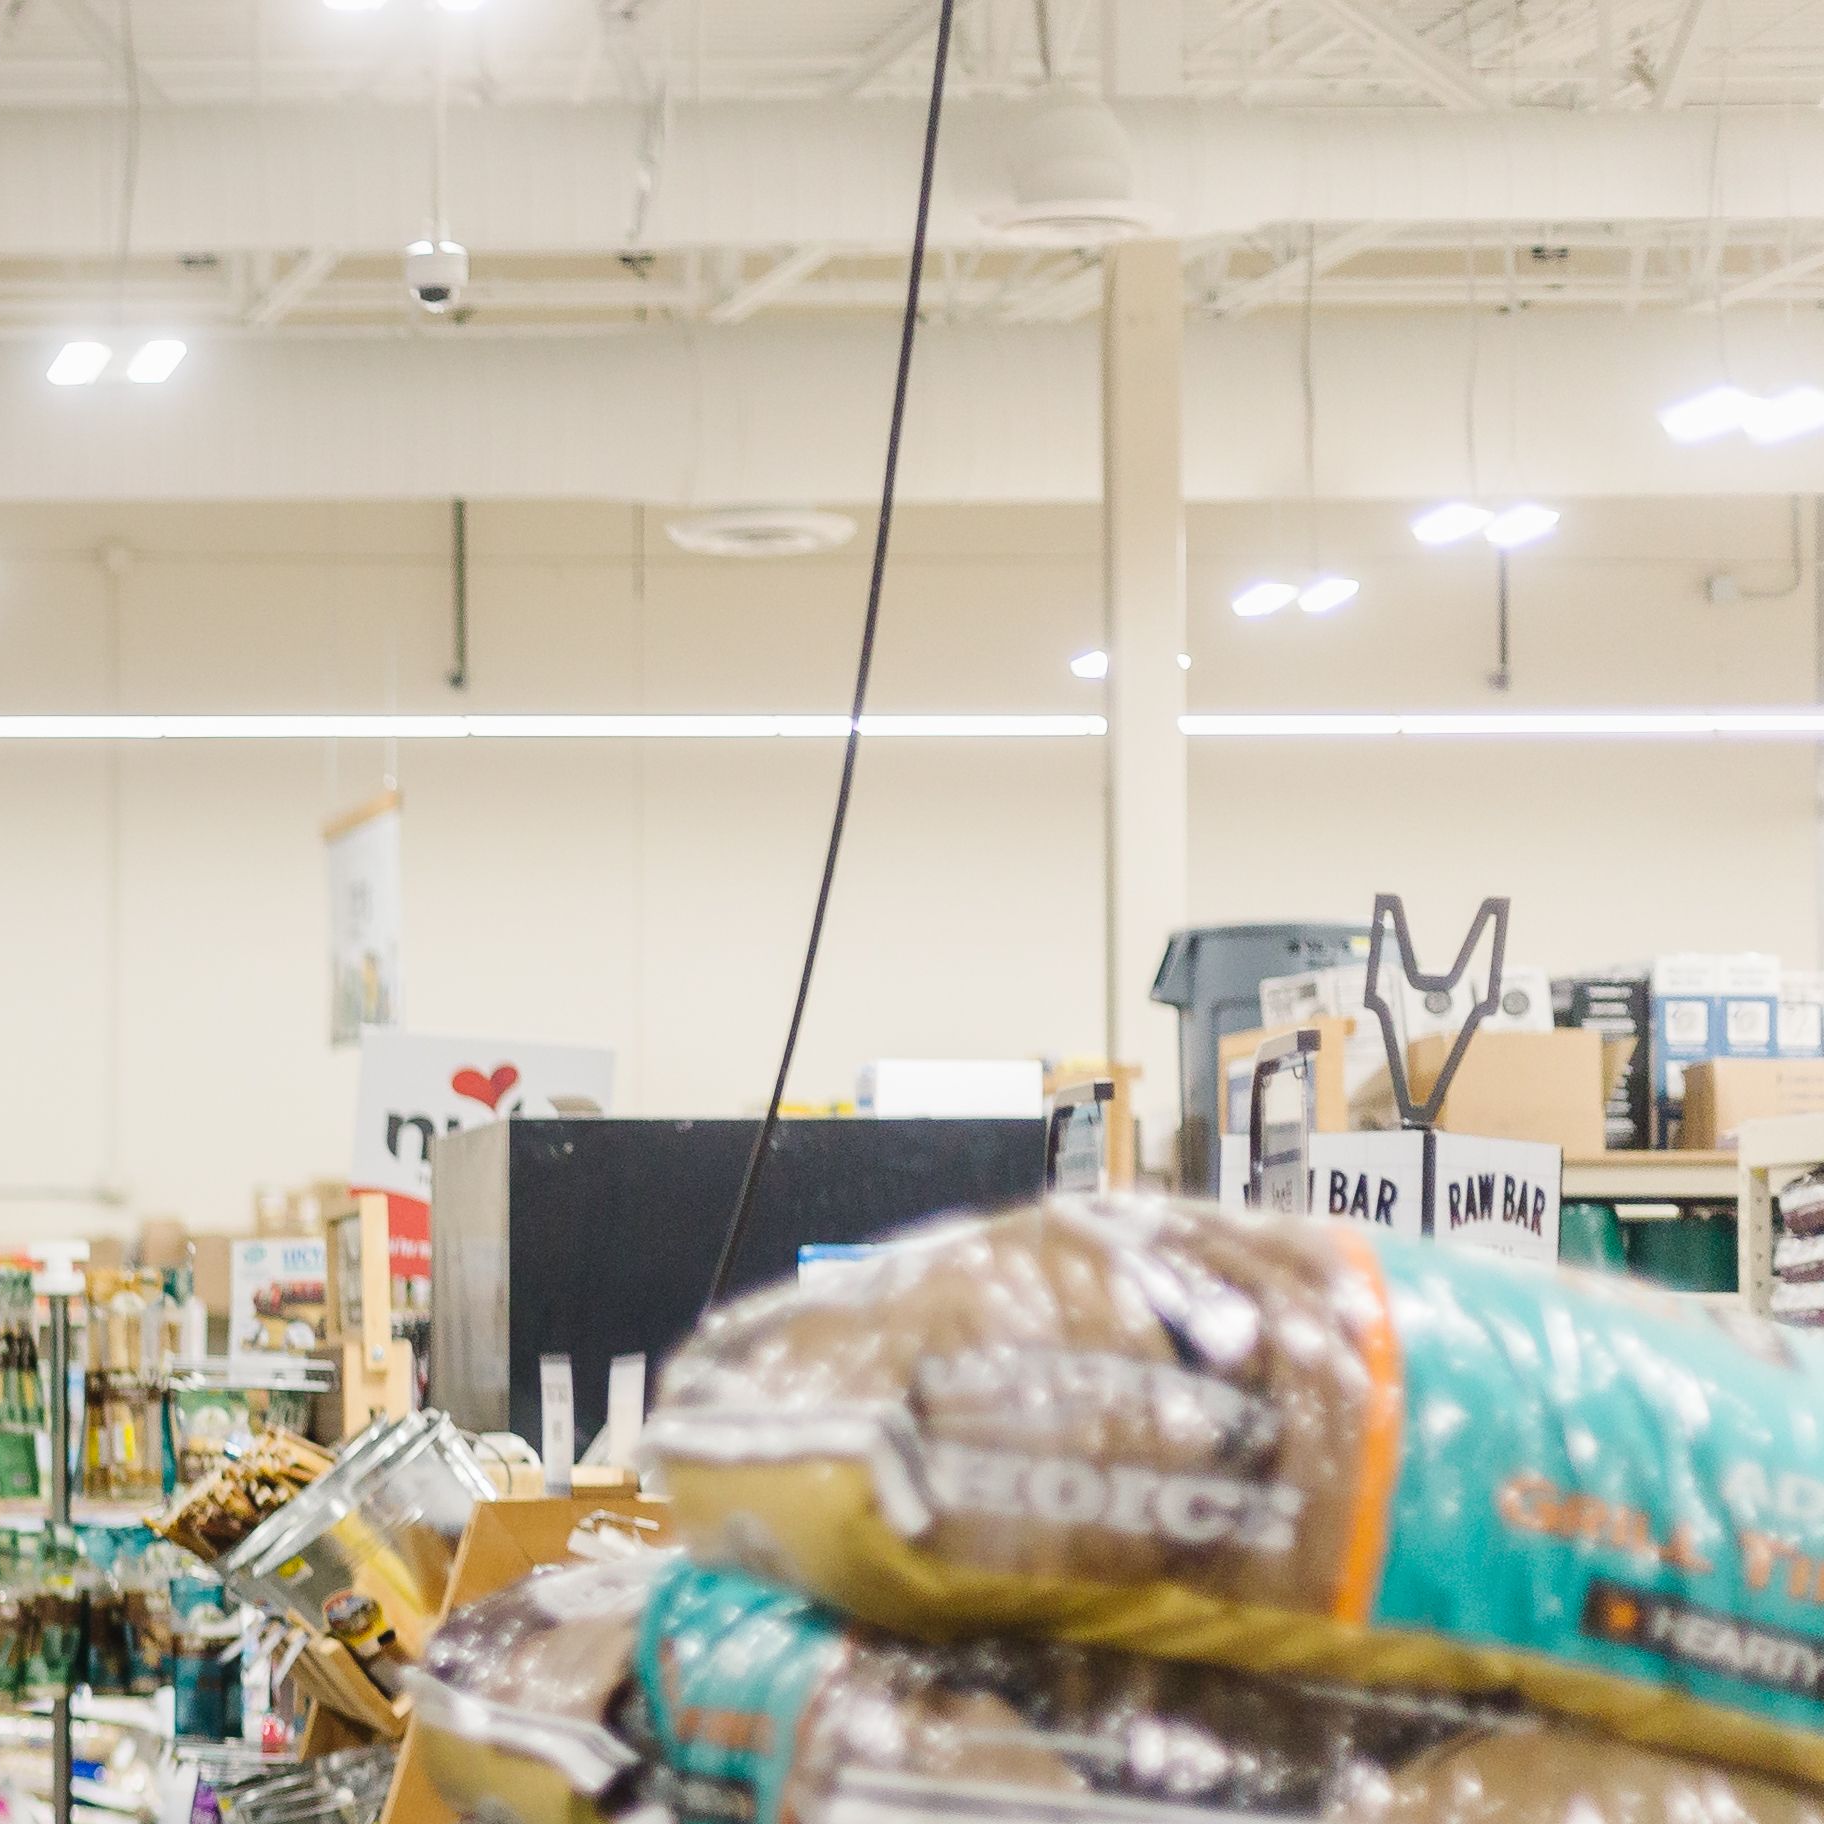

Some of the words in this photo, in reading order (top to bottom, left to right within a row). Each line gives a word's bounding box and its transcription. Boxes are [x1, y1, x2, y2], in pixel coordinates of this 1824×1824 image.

[1328, 1169, 1398, 1227] BAR
[1448, 1173, 1496, 1230] RAW
[1502, 1175, 1546, 1236] BAR
[924, 1440, 1305, 1552] HOICE
